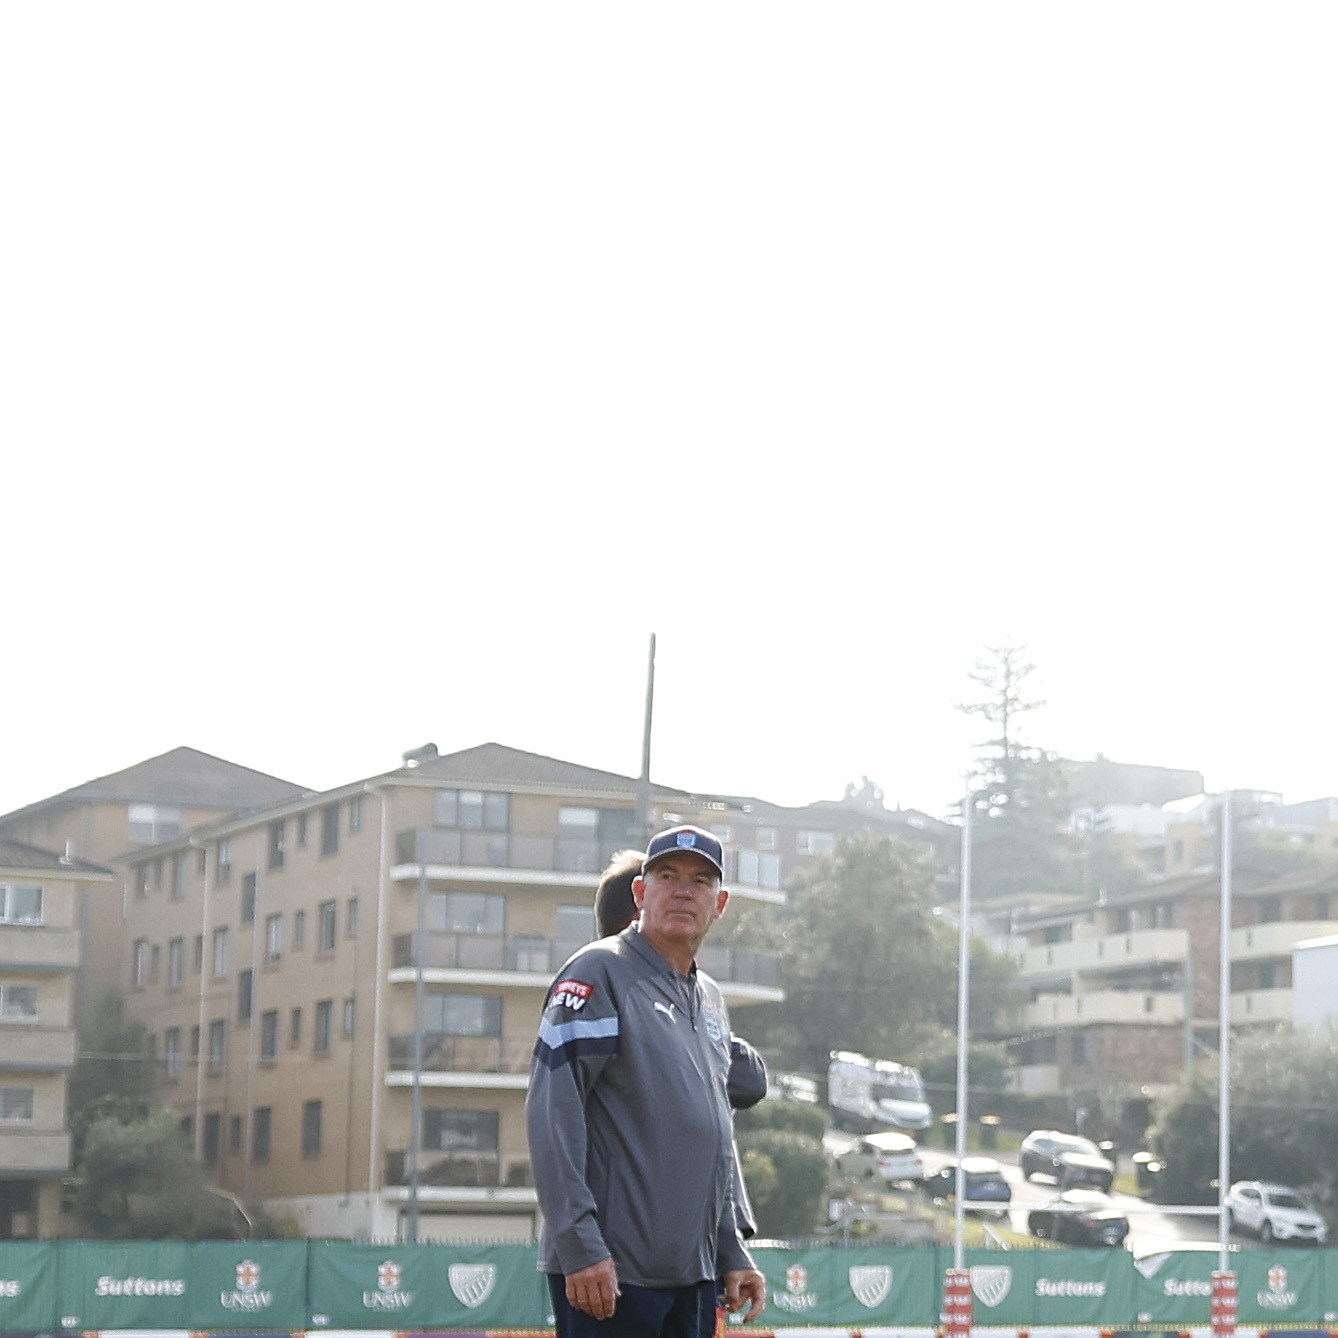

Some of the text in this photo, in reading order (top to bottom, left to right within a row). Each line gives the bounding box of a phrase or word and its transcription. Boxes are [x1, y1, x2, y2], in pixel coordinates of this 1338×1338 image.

[95, 1276, 186, 1296] Suttons
[1035, 1278, 1107, 1297] Suttons
[1163, 1279, 1212, 1297] Sutto
[220, 1291, 273, 1308] UNSW
